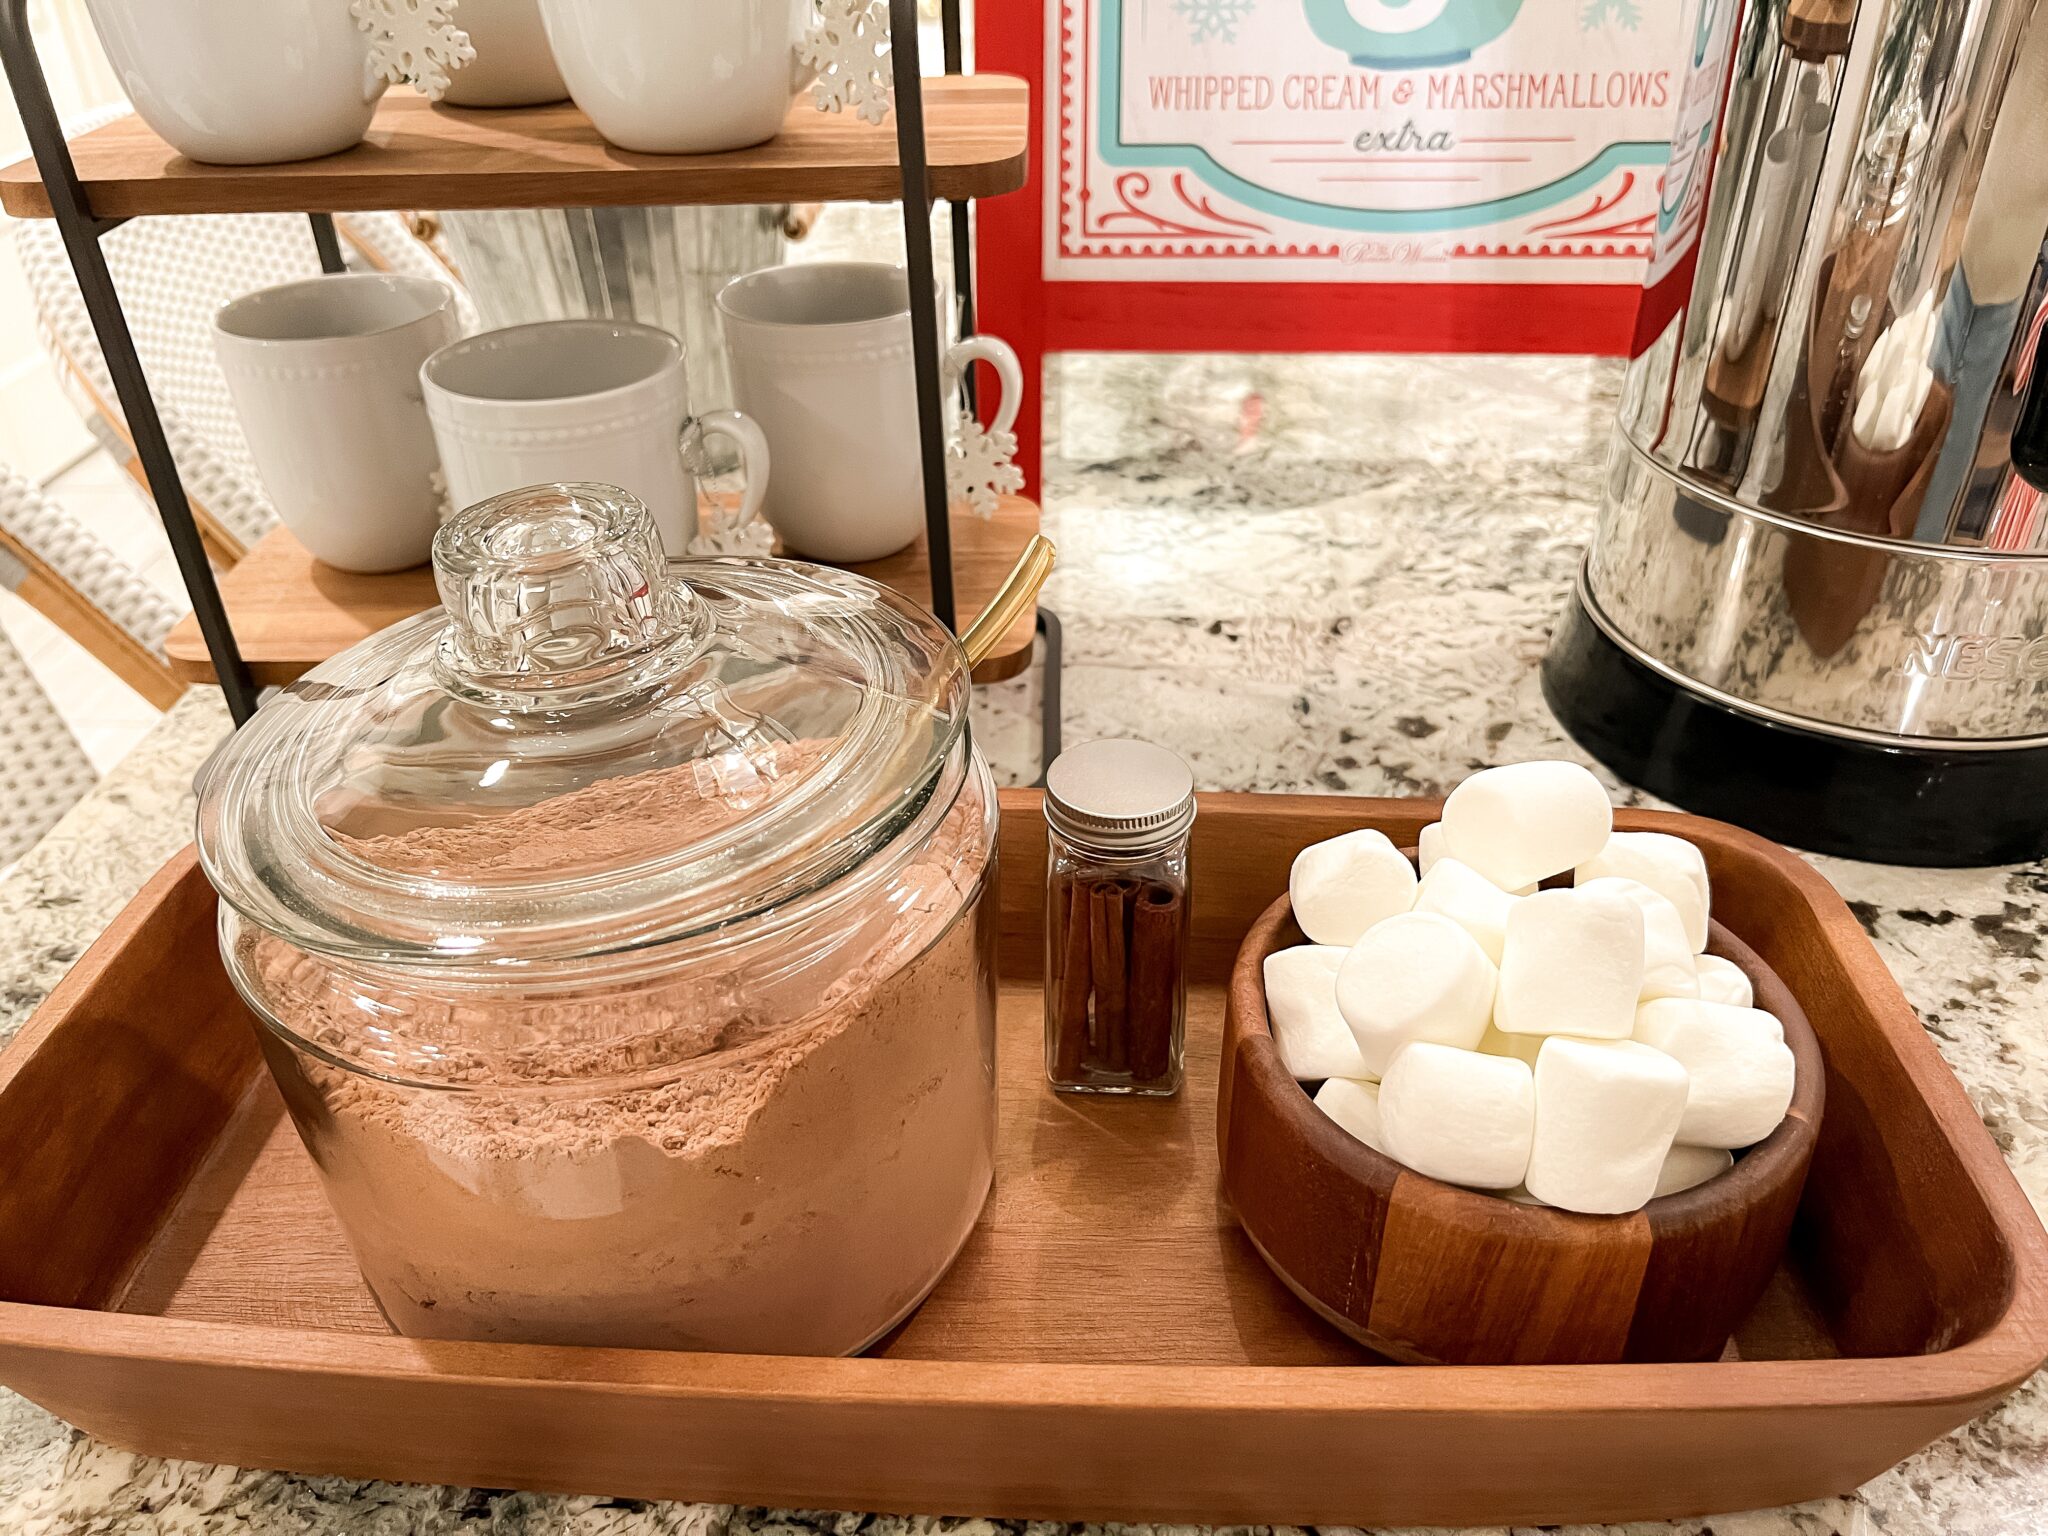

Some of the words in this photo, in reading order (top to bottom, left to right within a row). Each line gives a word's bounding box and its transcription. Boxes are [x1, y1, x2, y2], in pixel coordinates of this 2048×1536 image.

[1149, 74, 1274, 111] WHIPPED
[1282, 73, 1384, 111] CREAM
[1391, 78, 1414, 105] &
[1426, 70, 1670, 109] MARSHMALLOWS
[1353, 118, 1455, 152] extra
